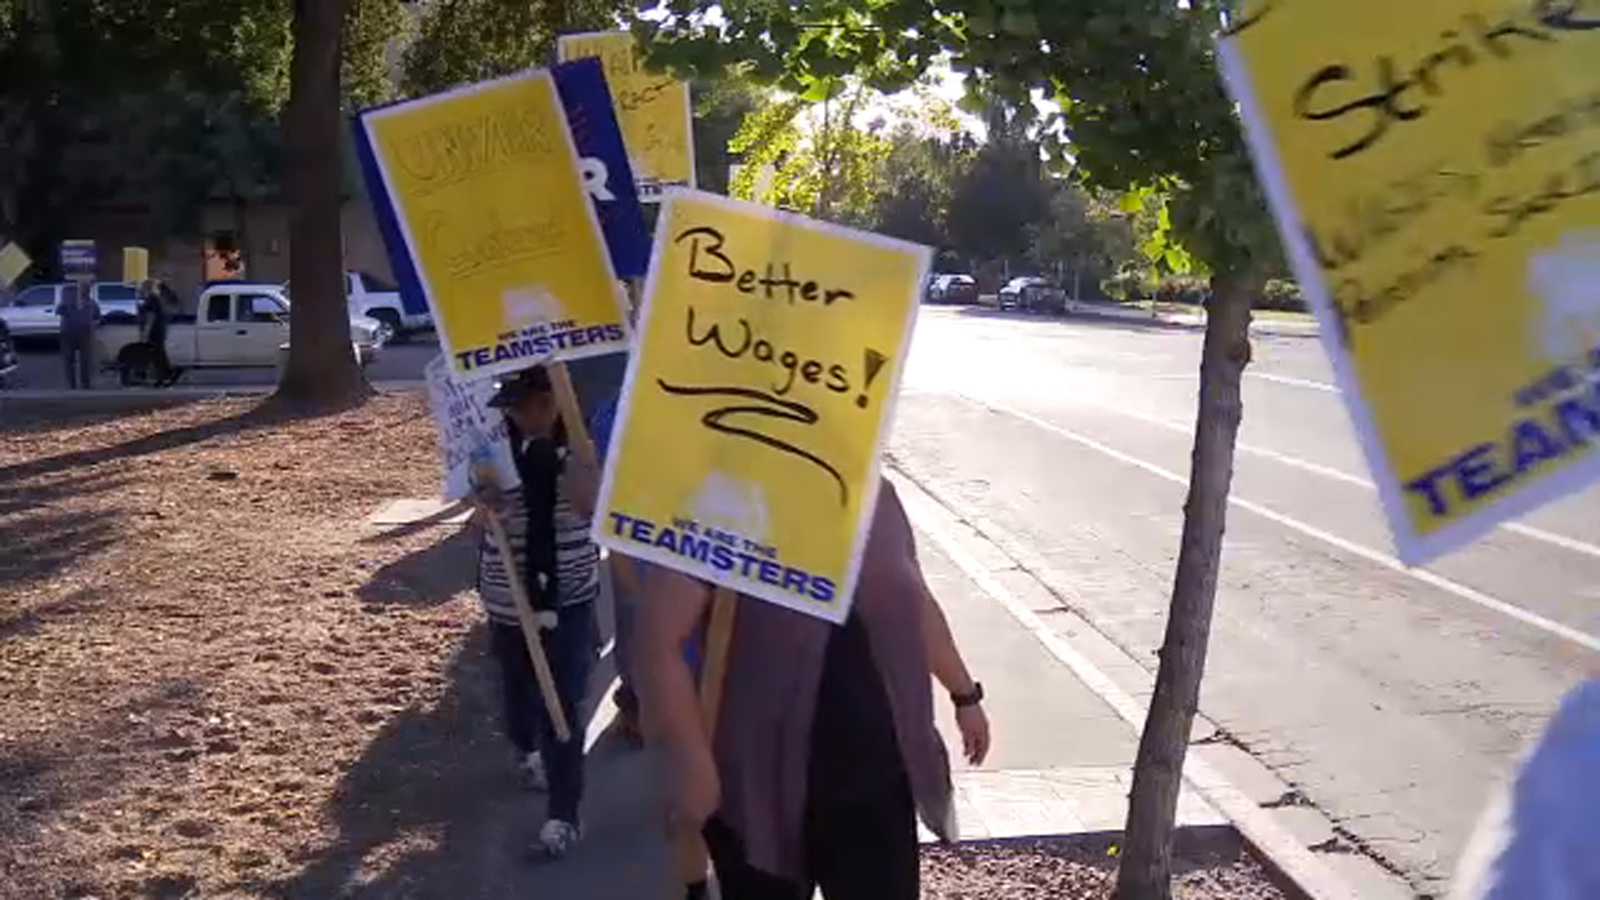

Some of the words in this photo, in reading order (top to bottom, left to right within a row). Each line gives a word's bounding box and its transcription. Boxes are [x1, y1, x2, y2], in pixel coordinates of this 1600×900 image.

[674, 227, 855, 306] Better
[455, 323, 625, 370] TEAMSTERS
[520, 324, 548, 337] ARE
[550, 319, 576, 331] THE
[686, 306, 889, 409] Wages!
[609, 511, 836, 602] TEAMSTERS
[672, 516, 698, 533] WE
[704, 527, 737, 546] ARE
[742, 538, 777, 559] THE
